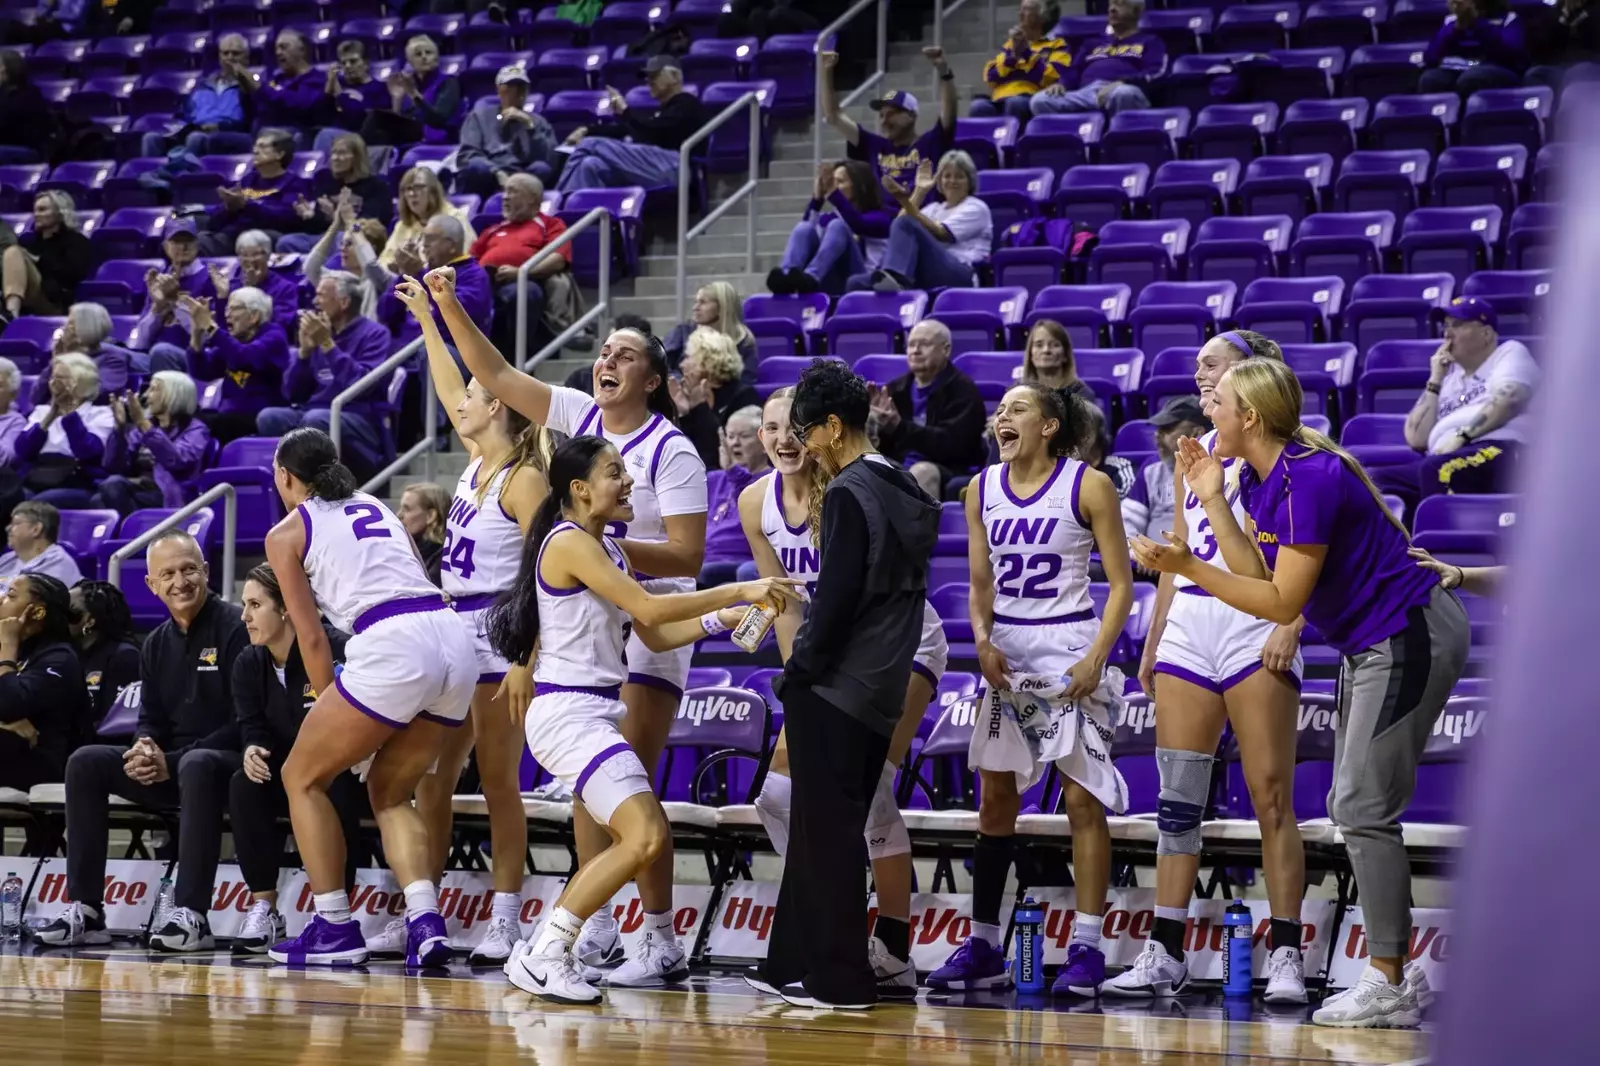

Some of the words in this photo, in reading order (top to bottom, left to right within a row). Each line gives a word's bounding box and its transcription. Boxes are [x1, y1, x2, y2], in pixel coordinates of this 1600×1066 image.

[344, 504, 392, 541] 2
[990, 518, 1059, 546] UNI
[440, 528, 476, 580] 24
[781, 547, 820, 573] UN
[998, 553, 1062, 599] 22
[38, 873, 147, 905] Hee
[296, 882, 407, 916] HVee
[438, 888, 543, 929] HyVe
[1022, 924, 1032, 981] POWERADE
